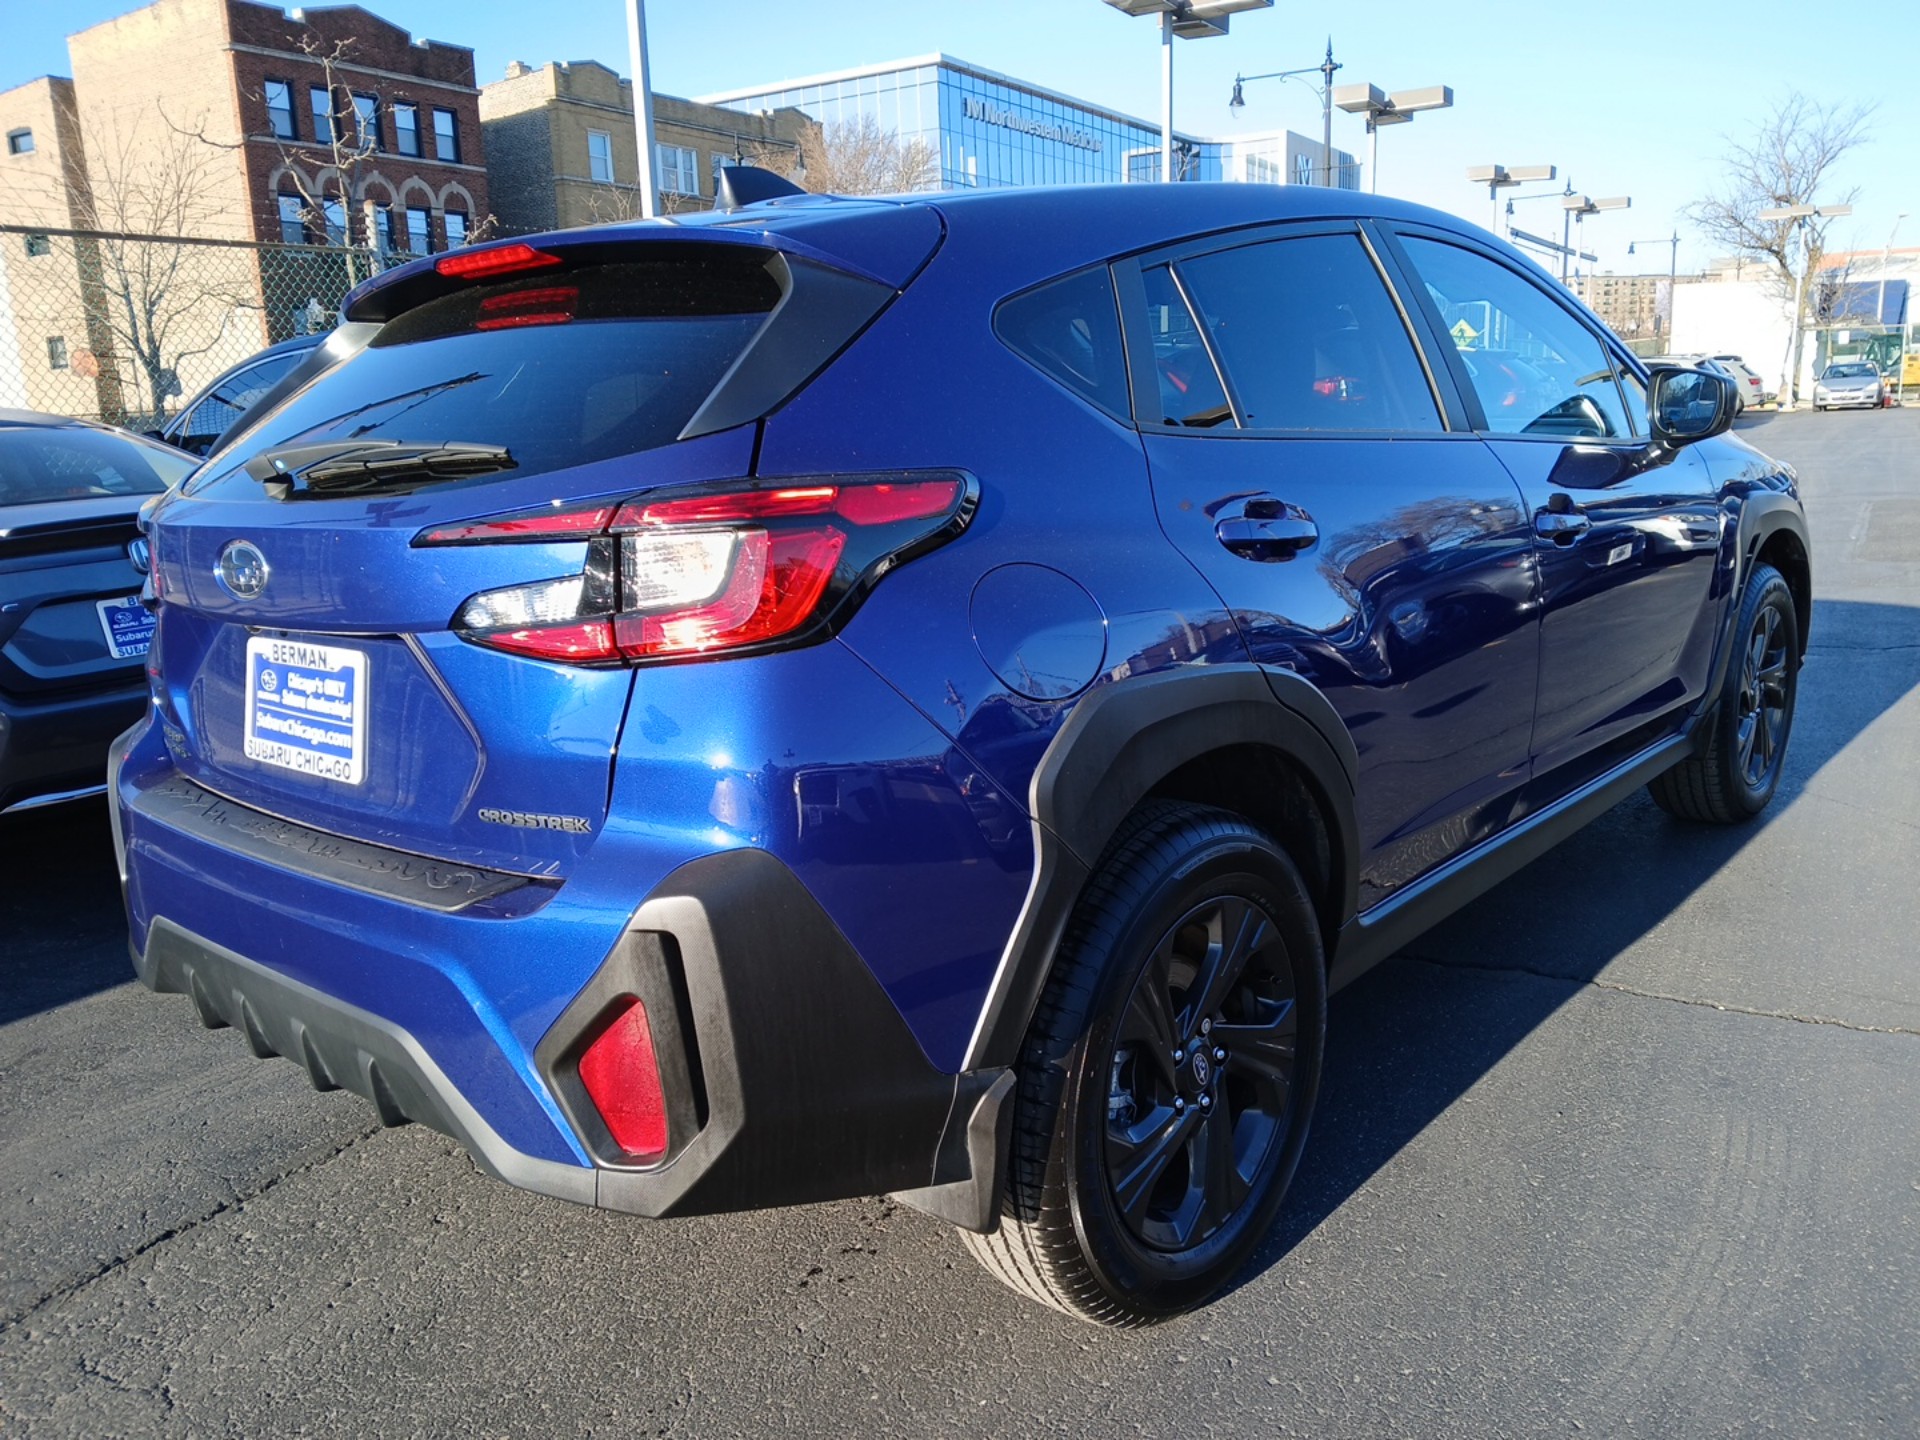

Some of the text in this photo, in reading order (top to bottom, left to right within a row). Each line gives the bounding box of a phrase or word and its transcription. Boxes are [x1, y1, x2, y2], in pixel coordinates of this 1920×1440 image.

[985, 103, 1061, 143] Northwestern
[118, 645, 149, 656] SUBA
[272, 643, 328, 669] BERMAN
[247, 739, 352, 780] SUBARU CHICAGO
[478, 808, 592, 834] CROSSTREK
